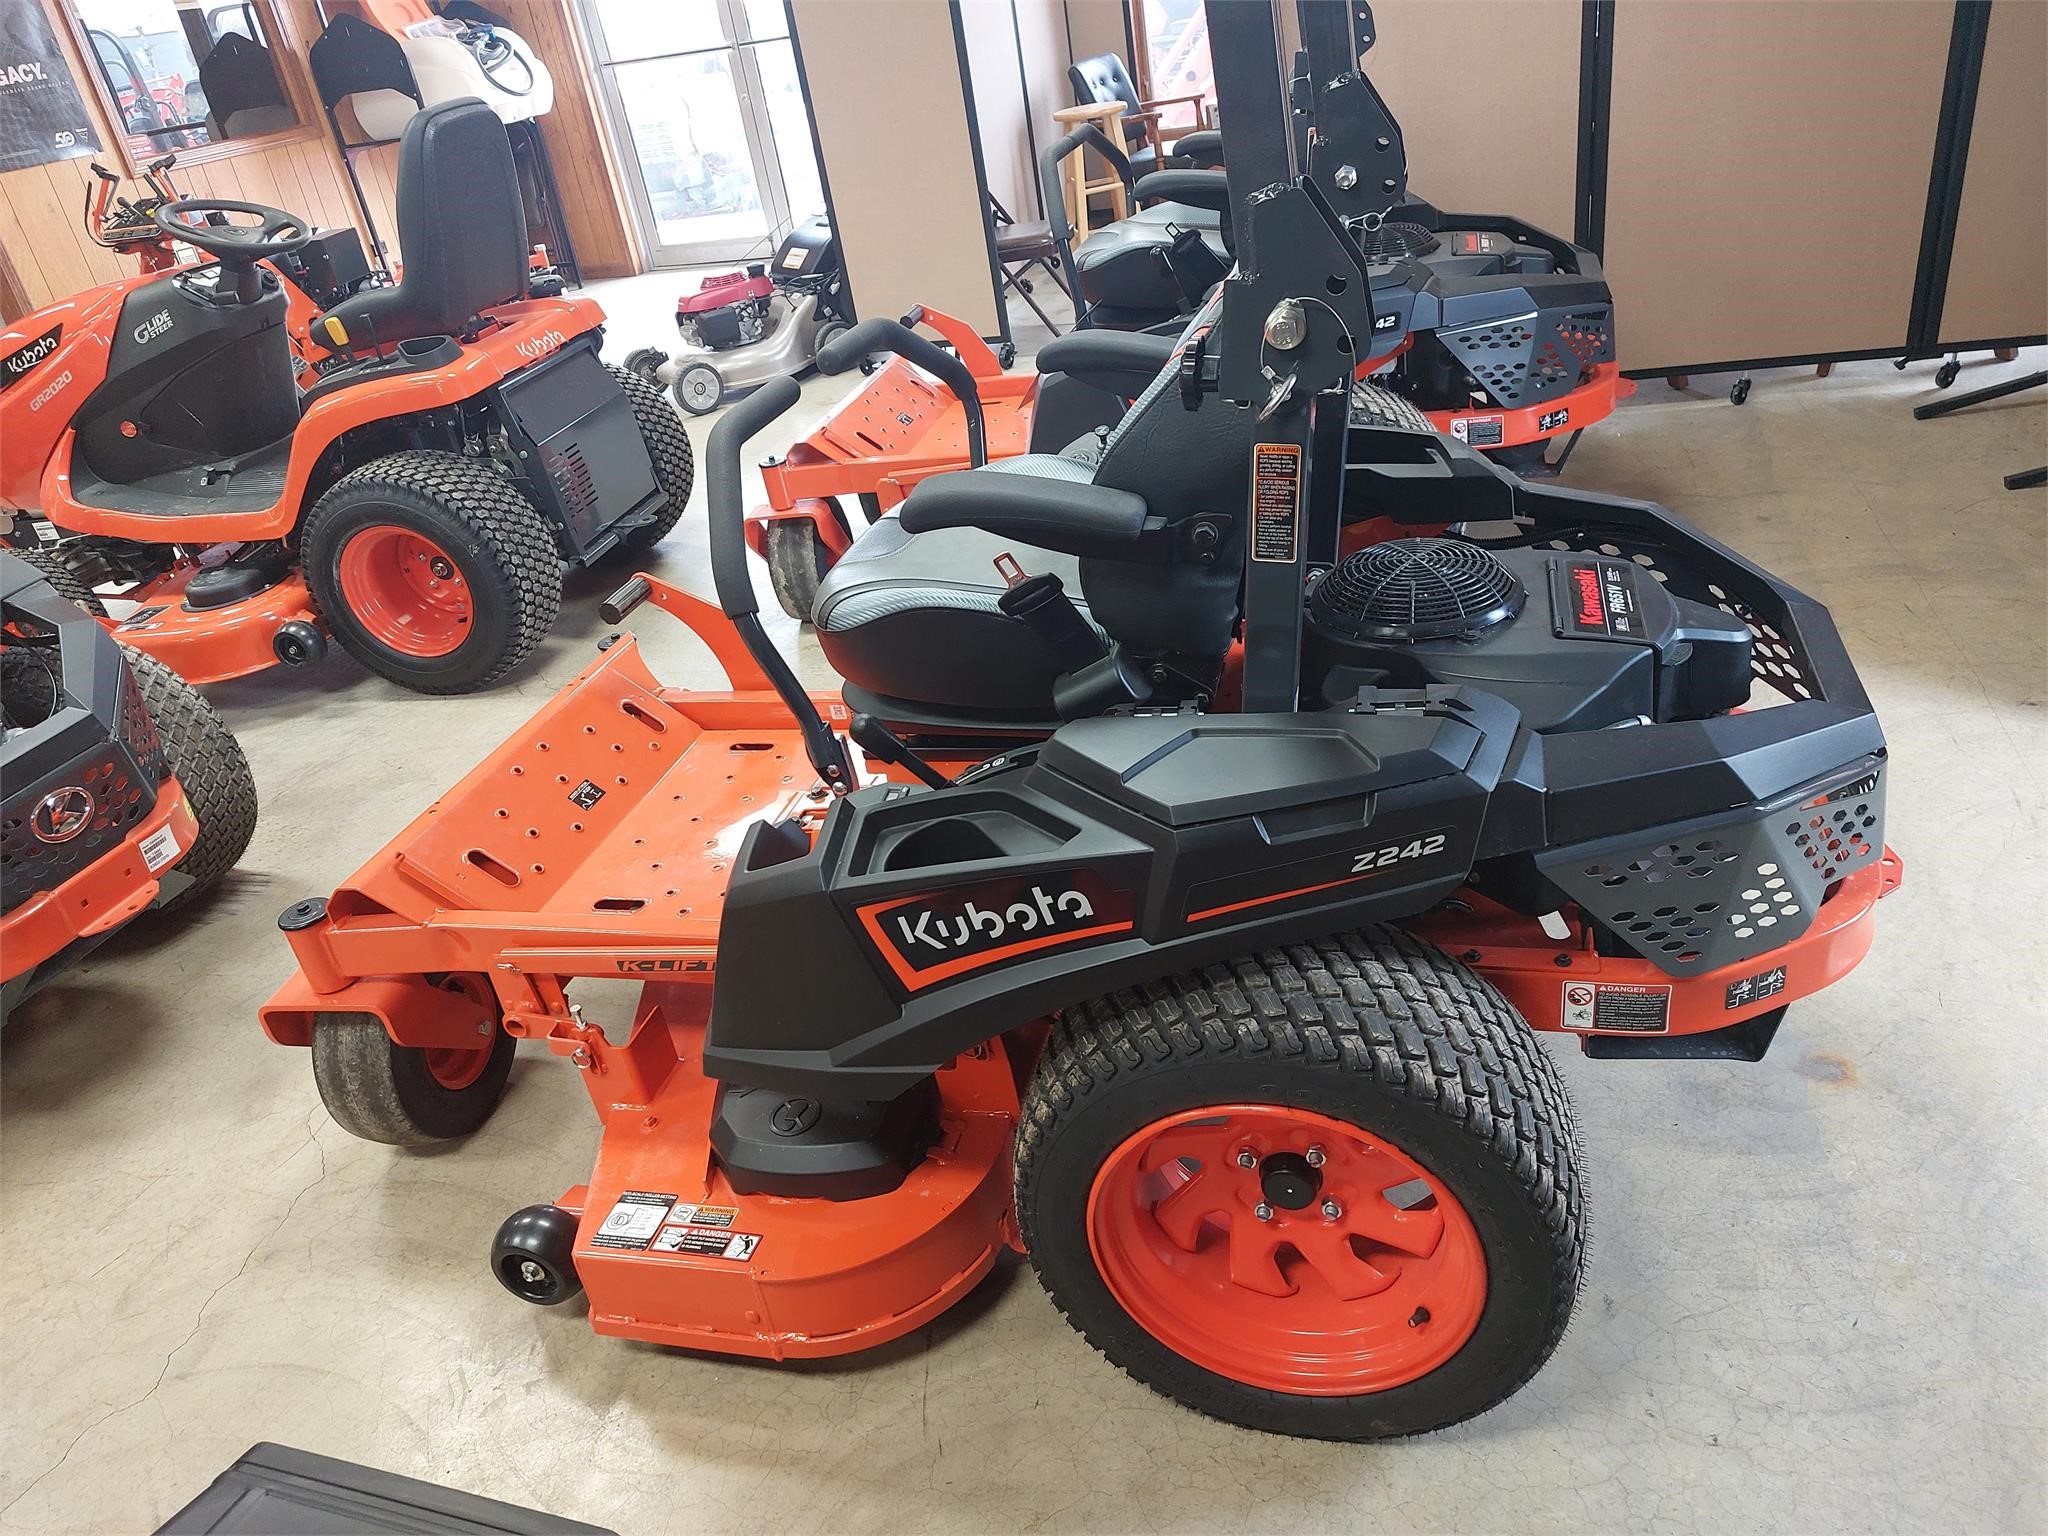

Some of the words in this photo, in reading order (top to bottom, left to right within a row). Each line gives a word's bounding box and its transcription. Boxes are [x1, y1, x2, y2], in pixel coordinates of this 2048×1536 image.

[133, 308, 171, 345] GLIDE
[149, 320, 174, 339] STEER
[1375, 315, 1396, 329] 42
[7, 336, 58, 373] Kubota
[514, 329, 567, 358] Kubota
[30, 370, 73, 412] GR2020
[1265, 446, 1299, 454] WARNING
[1573, 568, 1604, 625] Kawasaki
[1606, 583, 1627, 614] FR651V
[1351, 834, 1446, 873] Z242
[897, 886, 1094, 950] Kubota
[622, 960, 716, 971] K-LIFT
[1607, 985, 1646, 993] DANGER
[698, 1229, 732, 1239] DANGER
